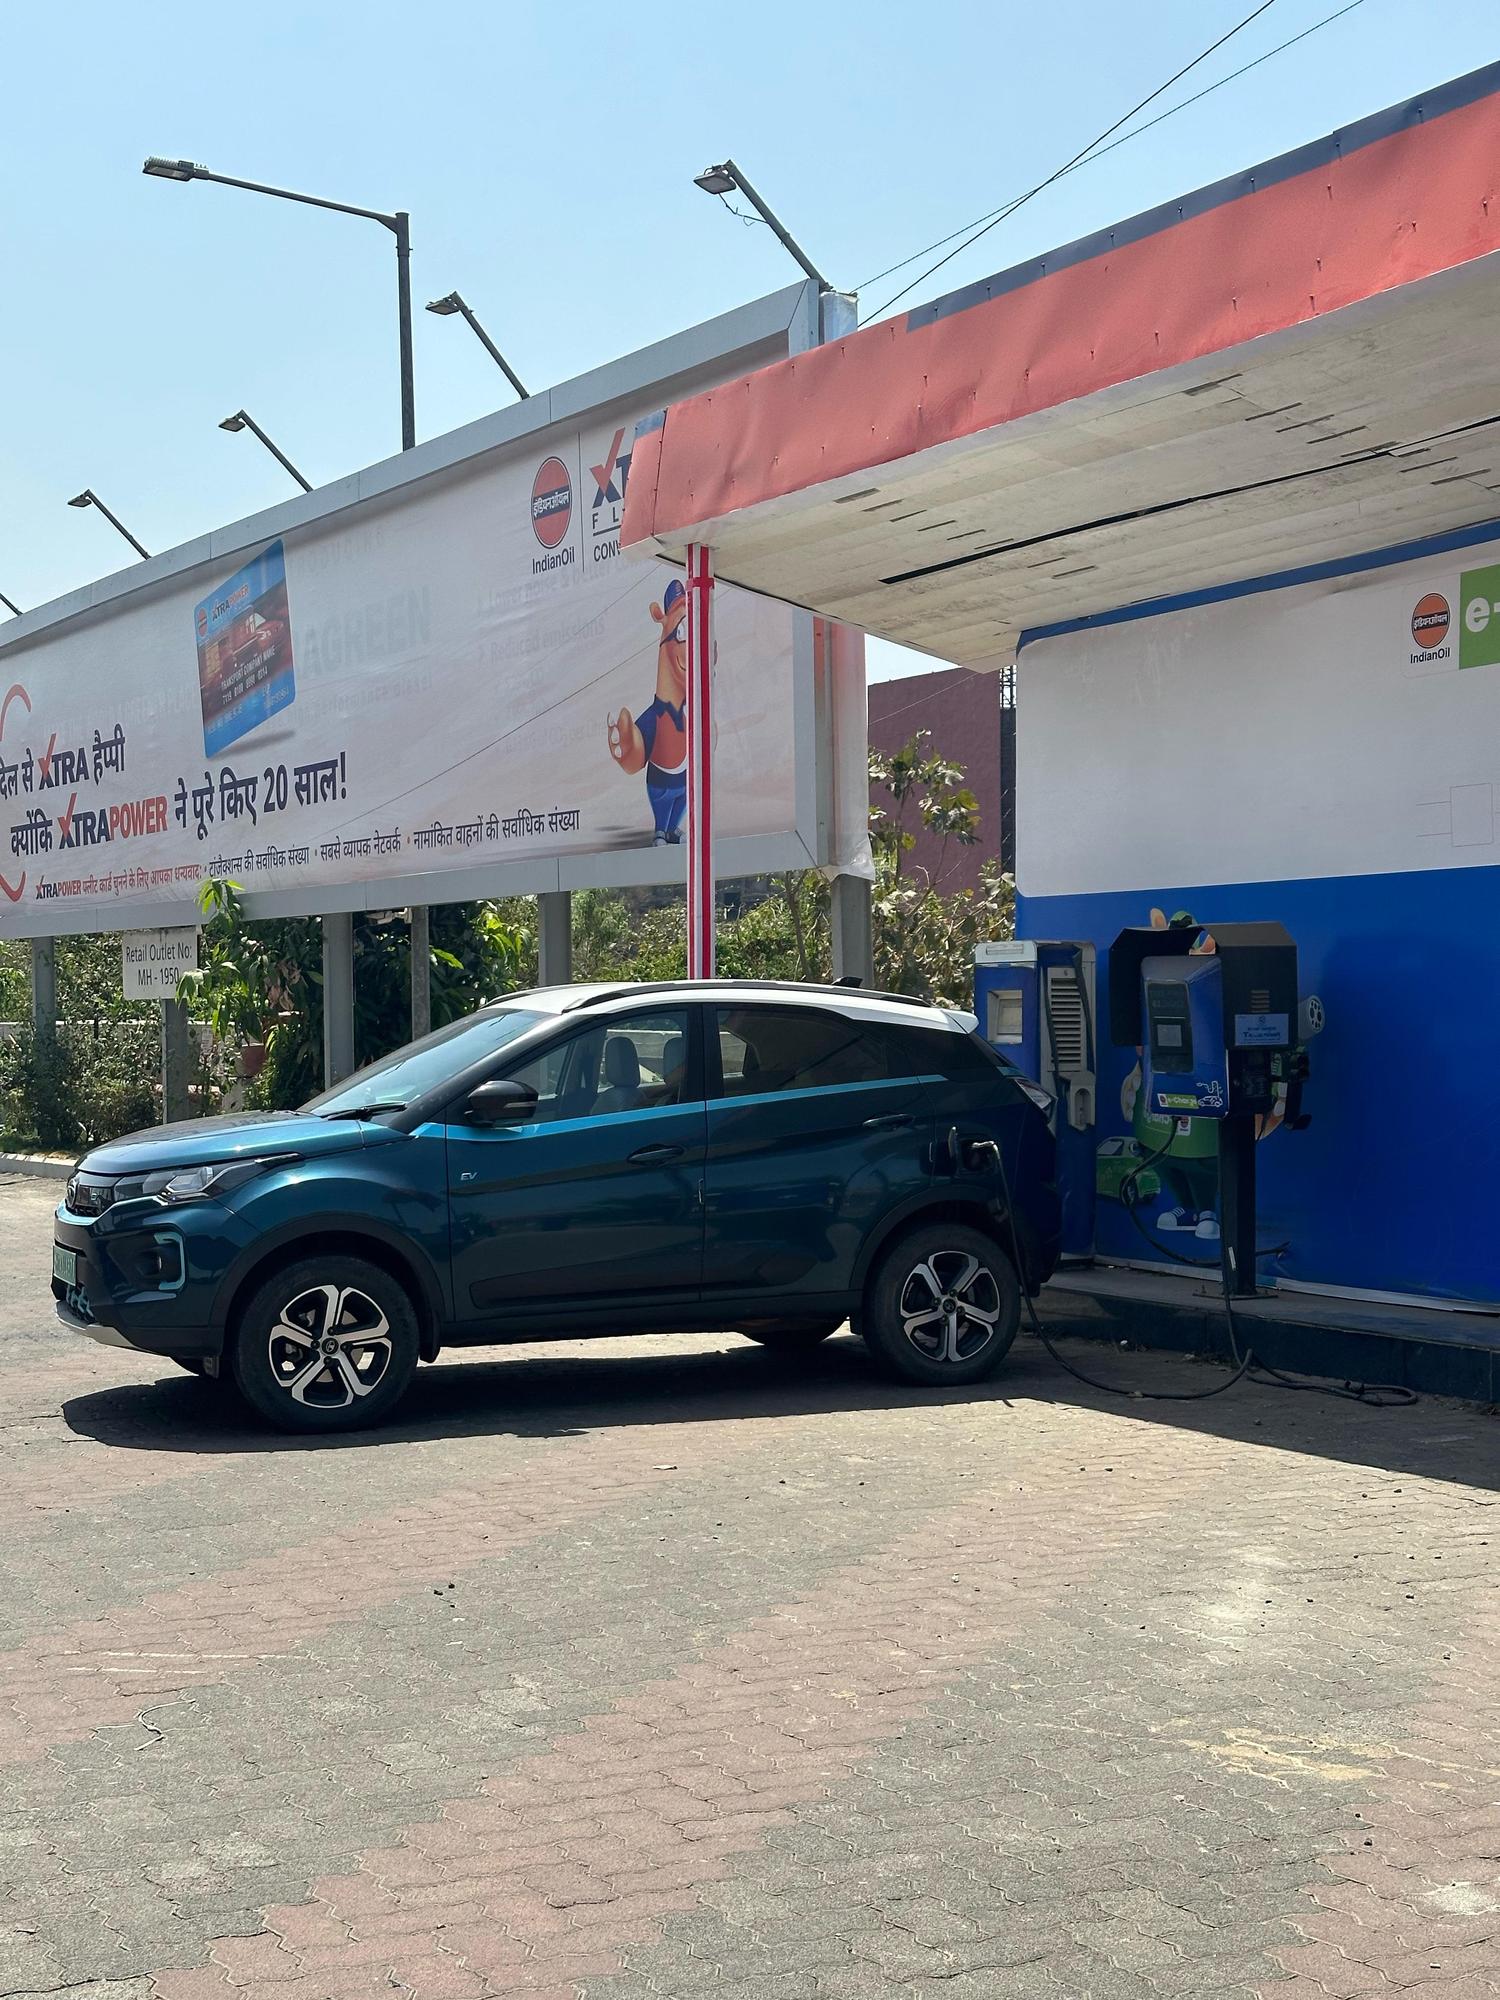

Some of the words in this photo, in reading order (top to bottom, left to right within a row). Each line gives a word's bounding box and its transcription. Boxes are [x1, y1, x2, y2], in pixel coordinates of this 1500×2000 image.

[532, 546, 575, 574] IndianOil
[1410, 647, 1450, 664] IndianOil
[21, 747, 34, 792] से
[38, 733, 89, 790] XTRA
[93, 723, 125, 786] हैप्पी
[10, 808, 53, 856] क्योंकि
[57, 792, 168, 849] XTRAPOWER
[174, 777, 188, 828] ने
[192, 771, 215, 840] पूरे
[219, 766, 258, 826] किए
[263, 764, 288, 813] 20
[294, 751, 347, 806] साल!
[35, 875, 82, 900] XTRAPOWER
[113, 869, 127, 896] चुनने
[128, 868, 136, 888] के
[136, 867, 150, 889] लिए
[150, 868, 173, 885] आपका
[244, 849, 254, 871] की
[255, 845, 286, 869] सर्वाधिक
[288, 843, 310, 866] संख्या
[320, 836, 341, 861] सबसे
[343, 838, 371, 858] व्यापक
[373, 827, 401, 855] नेटवर्क
[413, 821, 453, 850] नामांकित
[456, 815, 483, 848] वाहनों
[485, 813, 499, 840] की
[502, 808, 545, 839] सर्वाधिक
[548, 805, 580, 833] संख्या
[126, 944, 147, 962] Retail
[149, 943, 175, 961] Outlet
[177, 942, 192, 959] No:
[138, 968, 152, 986] MH
[160, 966, 180, 985] 1950
[460, 1172, 478, 1181] EV
